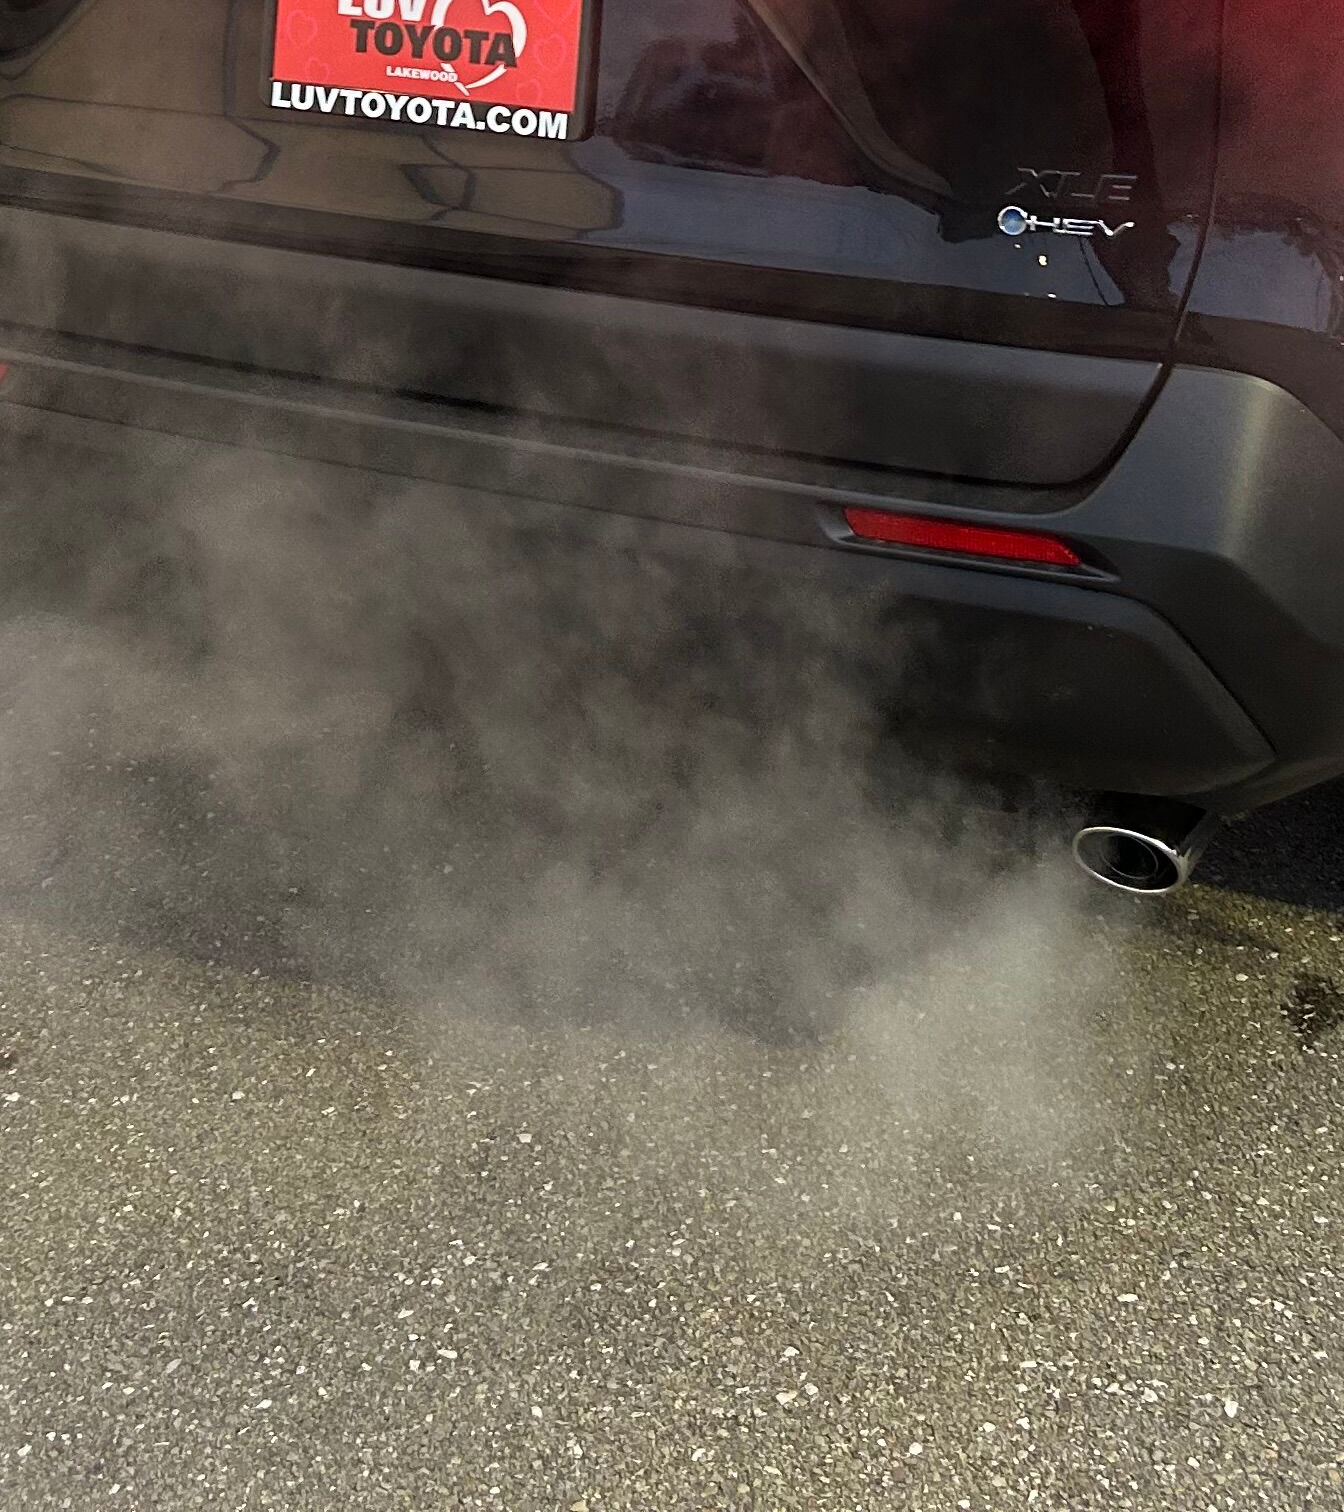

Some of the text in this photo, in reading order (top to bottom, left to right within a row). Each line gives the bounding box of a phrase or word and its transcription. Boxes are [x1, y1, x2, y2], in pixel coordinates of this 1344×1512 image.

[350, 19, 518, 68] TOYOTA
[386, 65, 458, 84] LAKEWOOD
[271, 81, 568, 140] LUVTOYOTA.COM
